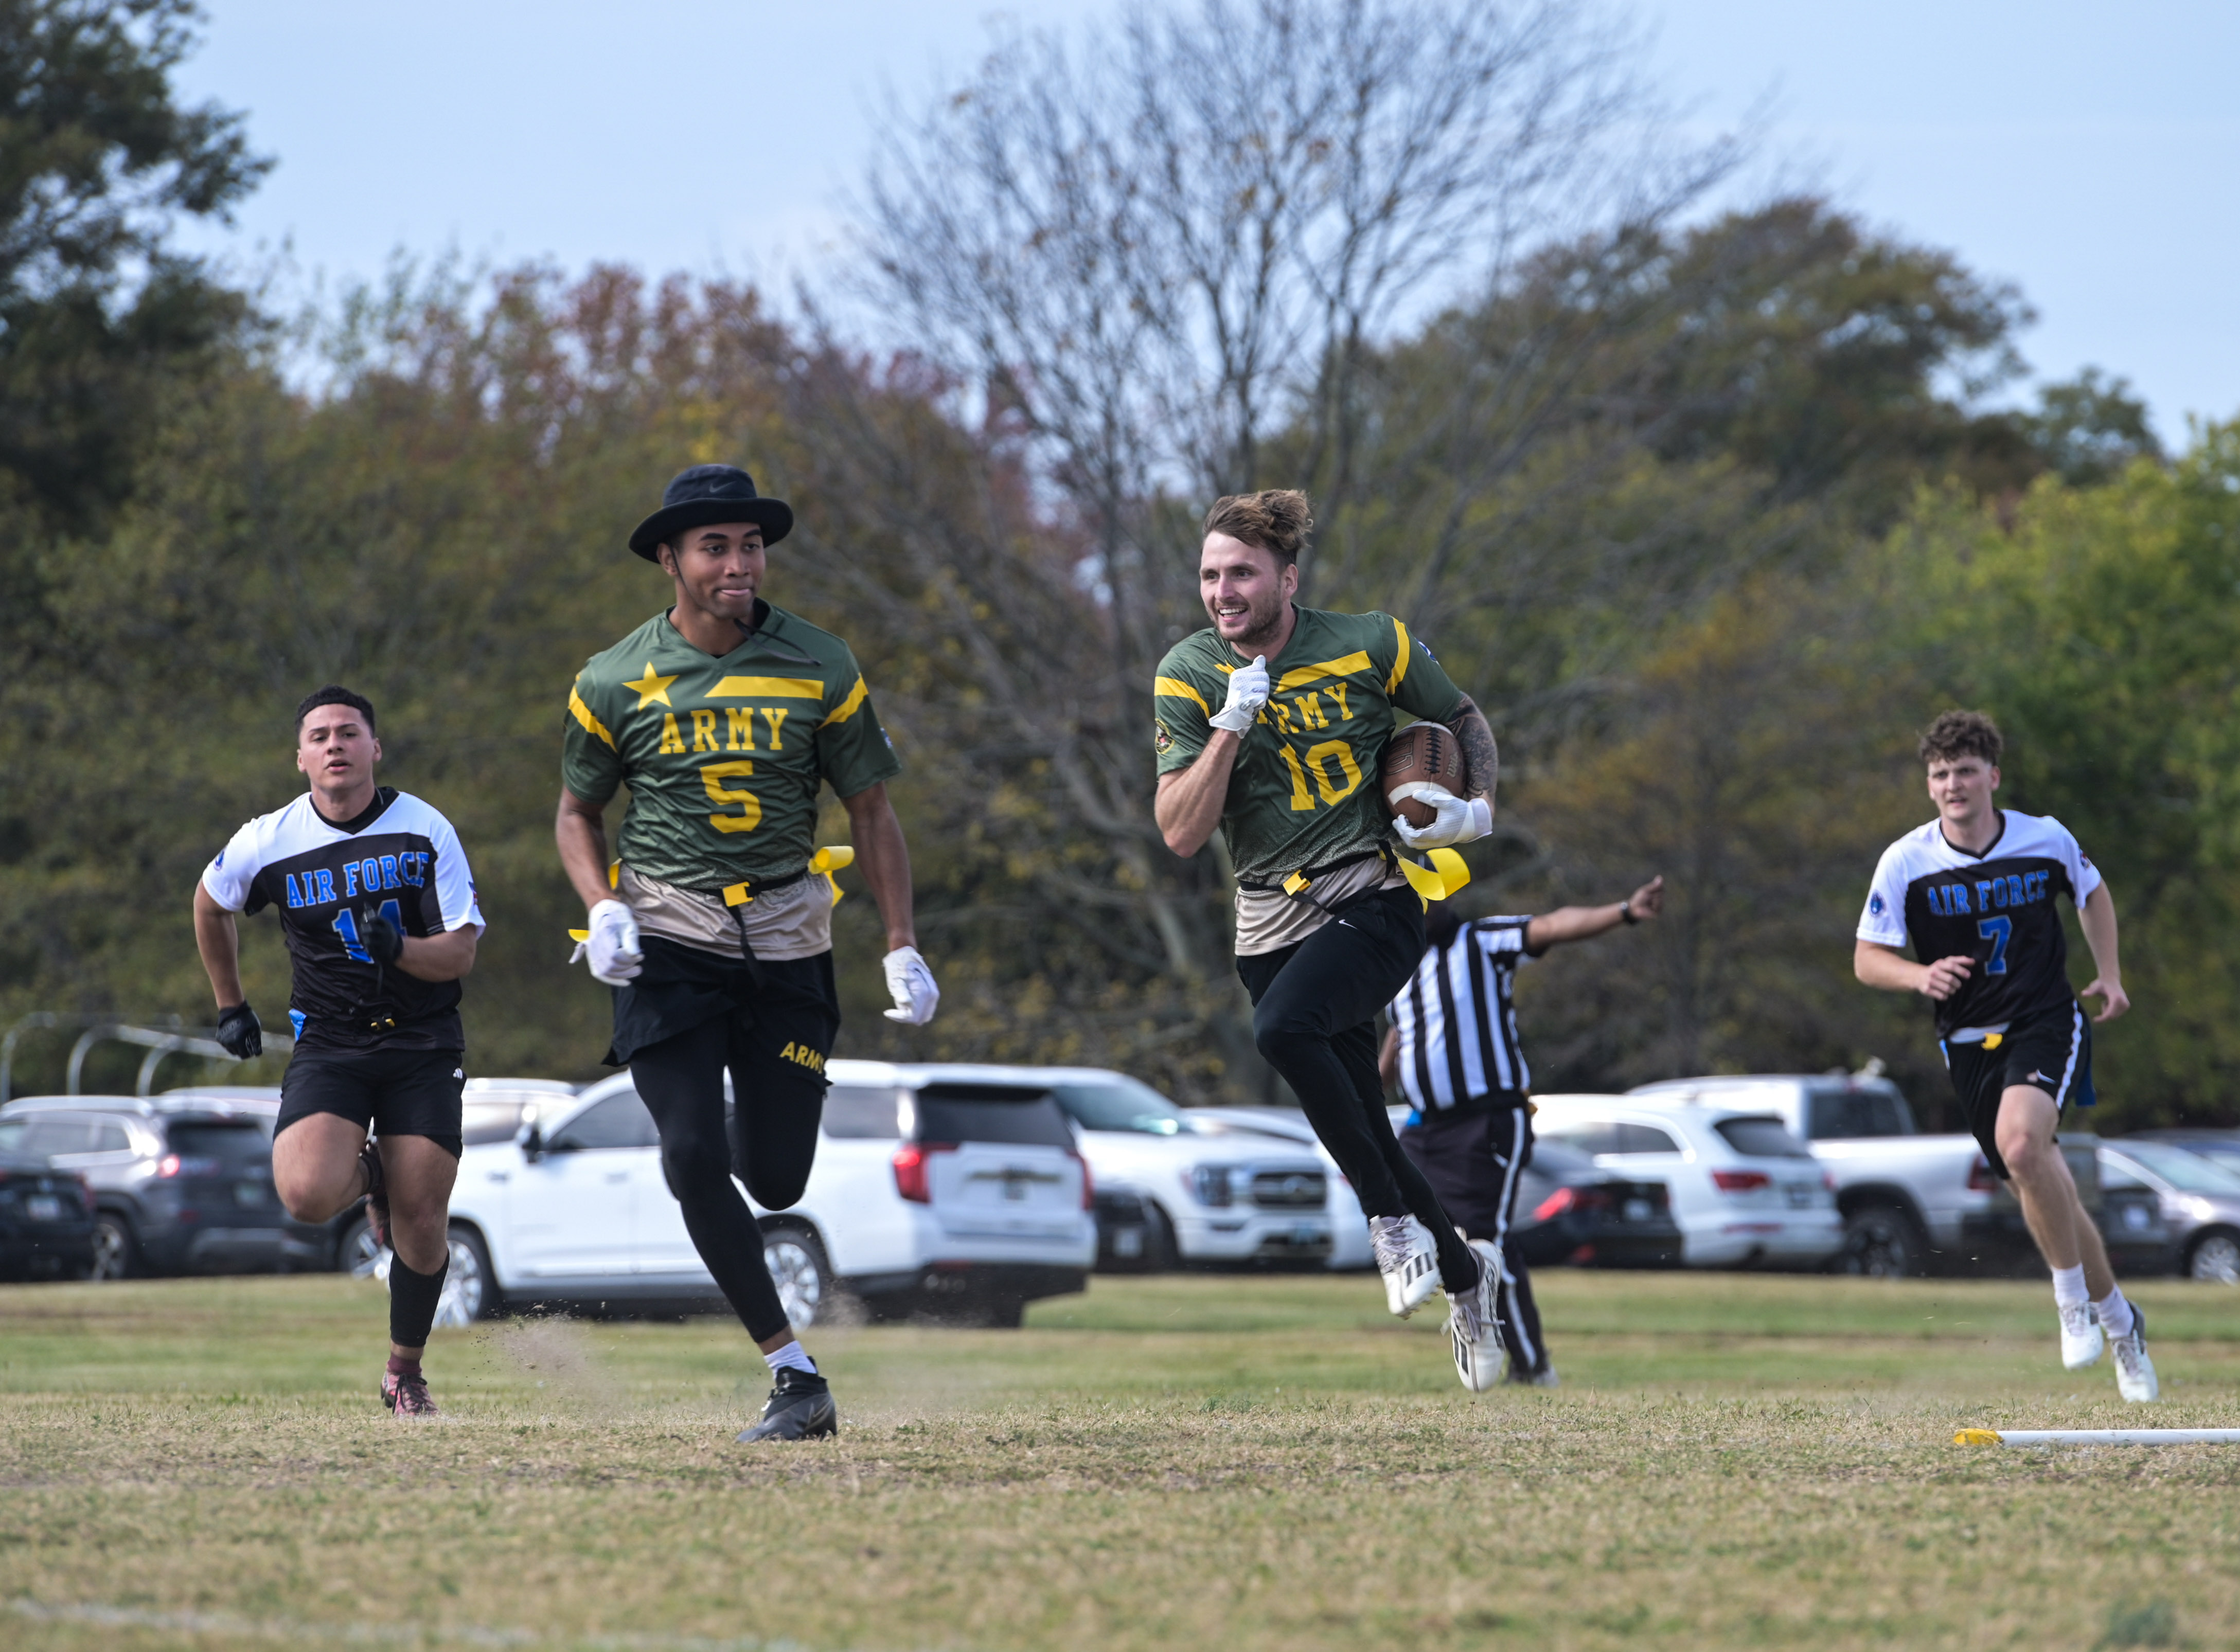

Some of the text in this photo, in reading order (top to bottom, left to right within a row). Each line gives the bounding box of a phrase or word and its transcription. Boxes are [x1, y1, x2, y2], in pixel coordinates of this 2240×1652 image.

[659, 707, 789, 754] ARMY
[700, 760, 762, 833] 5
[1278, 739, 1362, 811] 10
[286, 851, 430, 908] AIR FORCE
[1928, 883, 1971, 915] AIR
[1975, 869, 2049, 912] FORCE
[1977, 914, 2013, 976] 7
